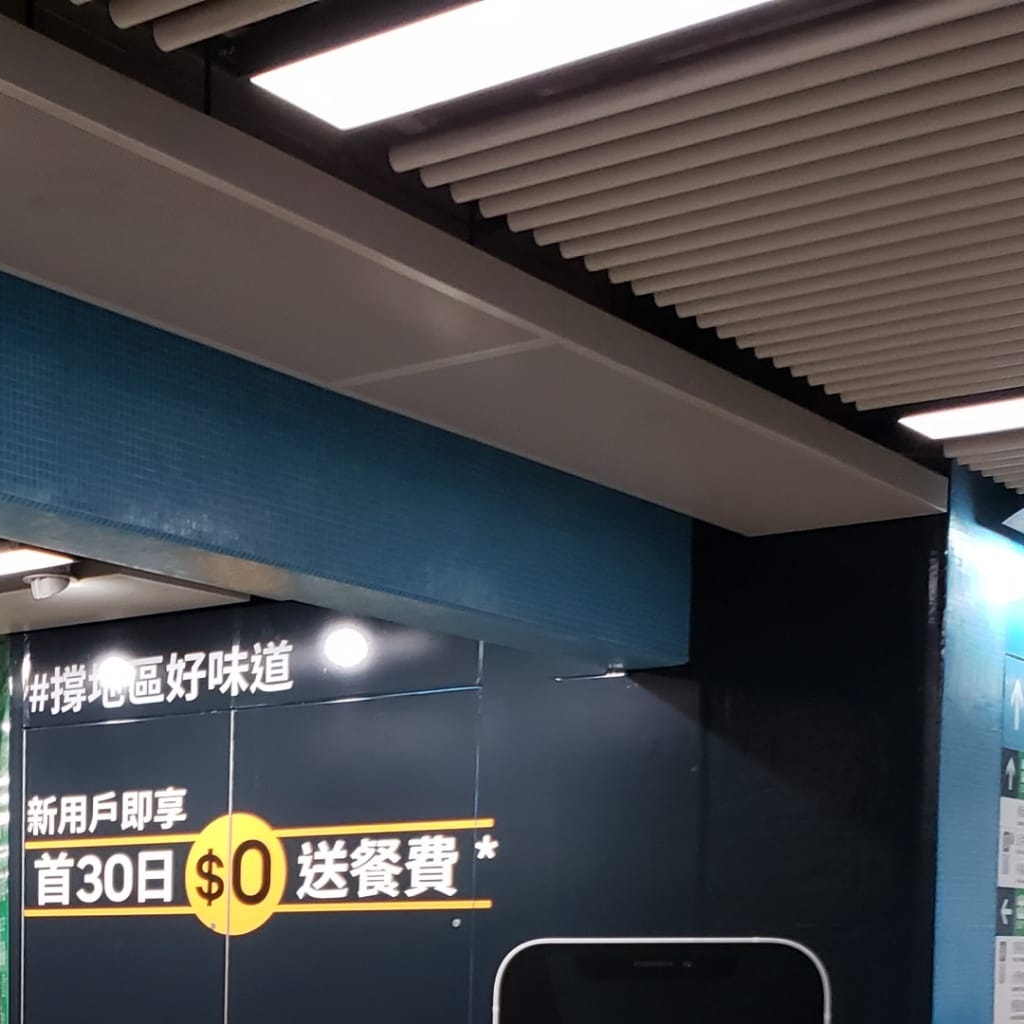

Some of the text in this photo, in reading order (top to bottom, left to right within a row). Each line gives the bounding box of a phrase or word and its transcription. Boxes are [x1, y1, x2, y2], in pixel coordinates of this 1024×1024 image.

[27, 787, 188, 836] 新用戶即享
[33, 850, 174, 906] 首30日
[195, 839, 272, 907] $0
